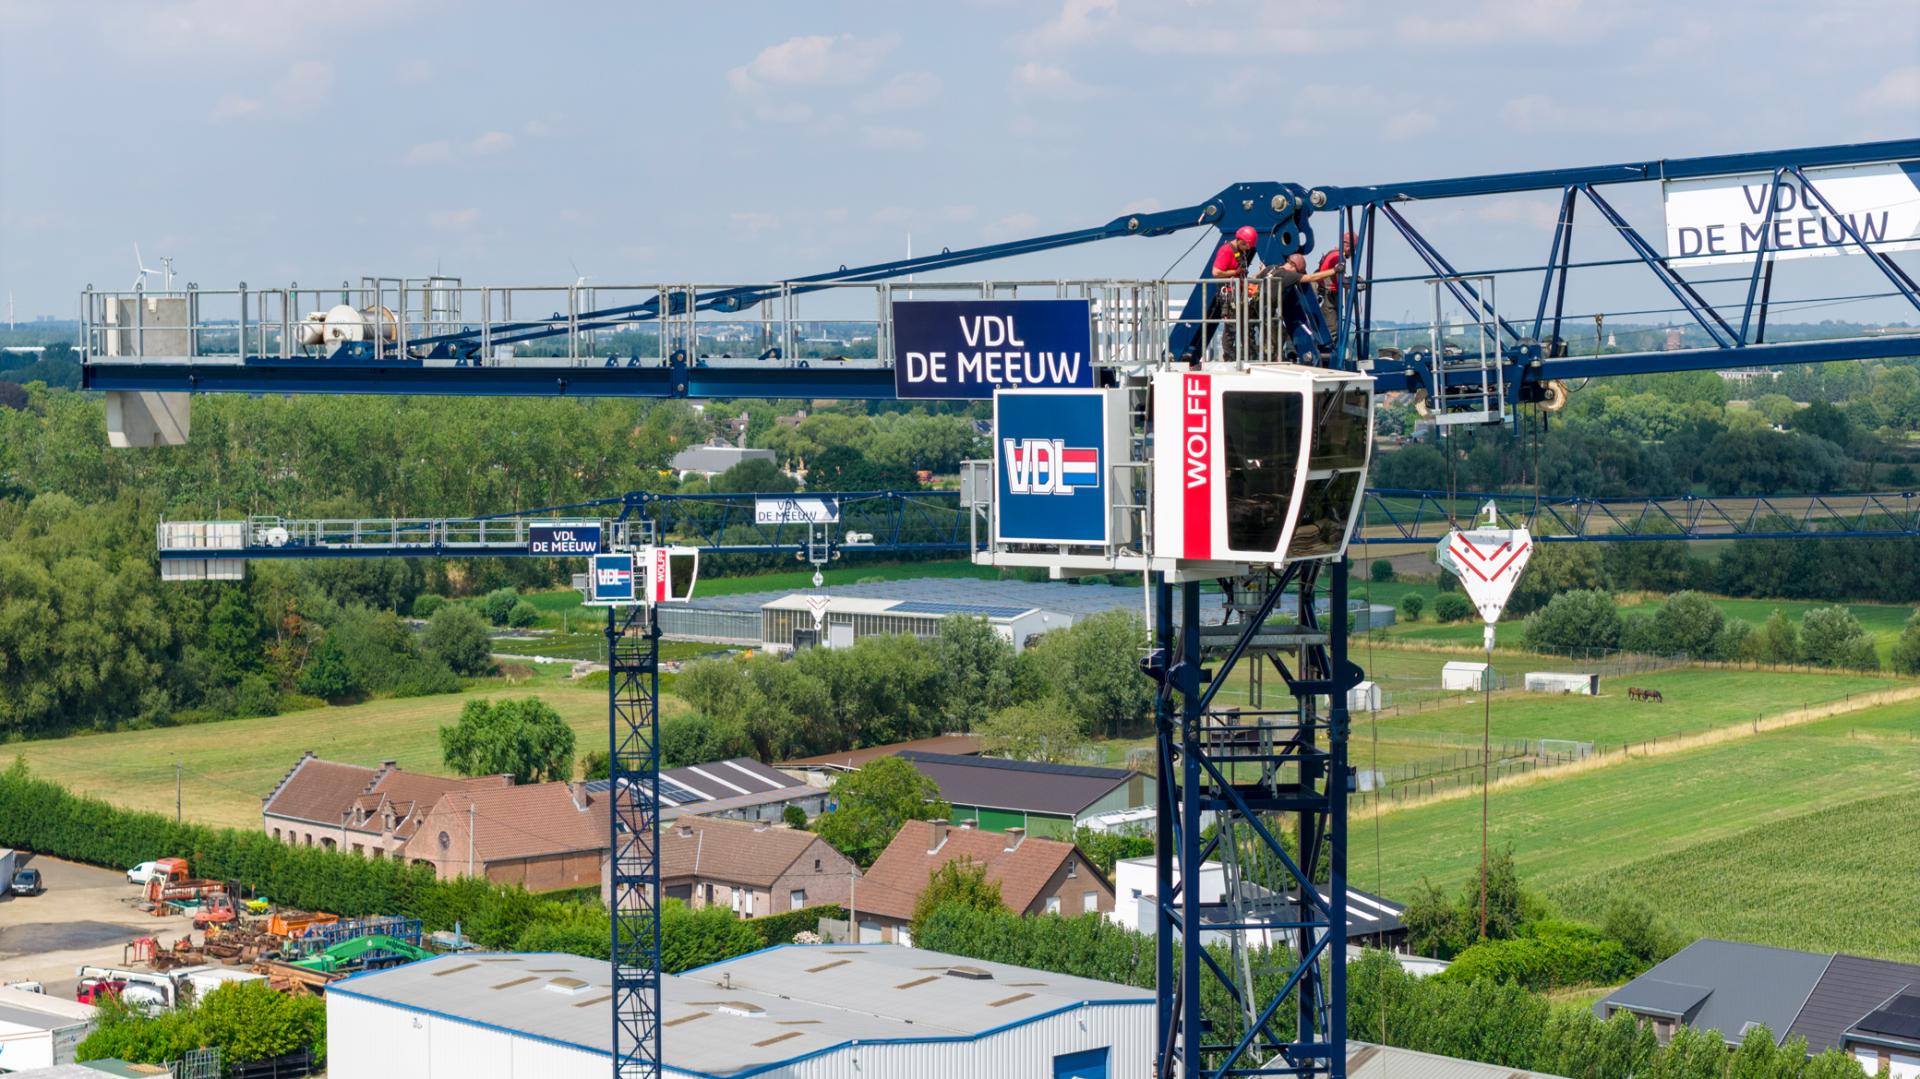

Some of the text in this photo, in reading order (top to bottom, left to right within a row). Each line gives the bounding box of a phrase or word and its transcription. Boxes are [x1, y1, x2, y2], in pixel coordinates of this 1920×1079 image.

[1743, 181, 1819, 215] VDL
[1678, 211, 1889, 258] DE MEEUW
[959, 315, 1025, 347] VDL
[906, 352, 1081, 384] DE MEEUW
[1187, 378, 1208, 489] WOLFF
[1003, 438, 1075, 496] VDL
[758, 511, 817, 521] DE MEEUW
[533, 542, 596, 552] DE MEEUW
[553, 531, 576, 541] VDL
[598, 569, 622, 585] VDL
[657, 551, 665, 582] WOLFF
